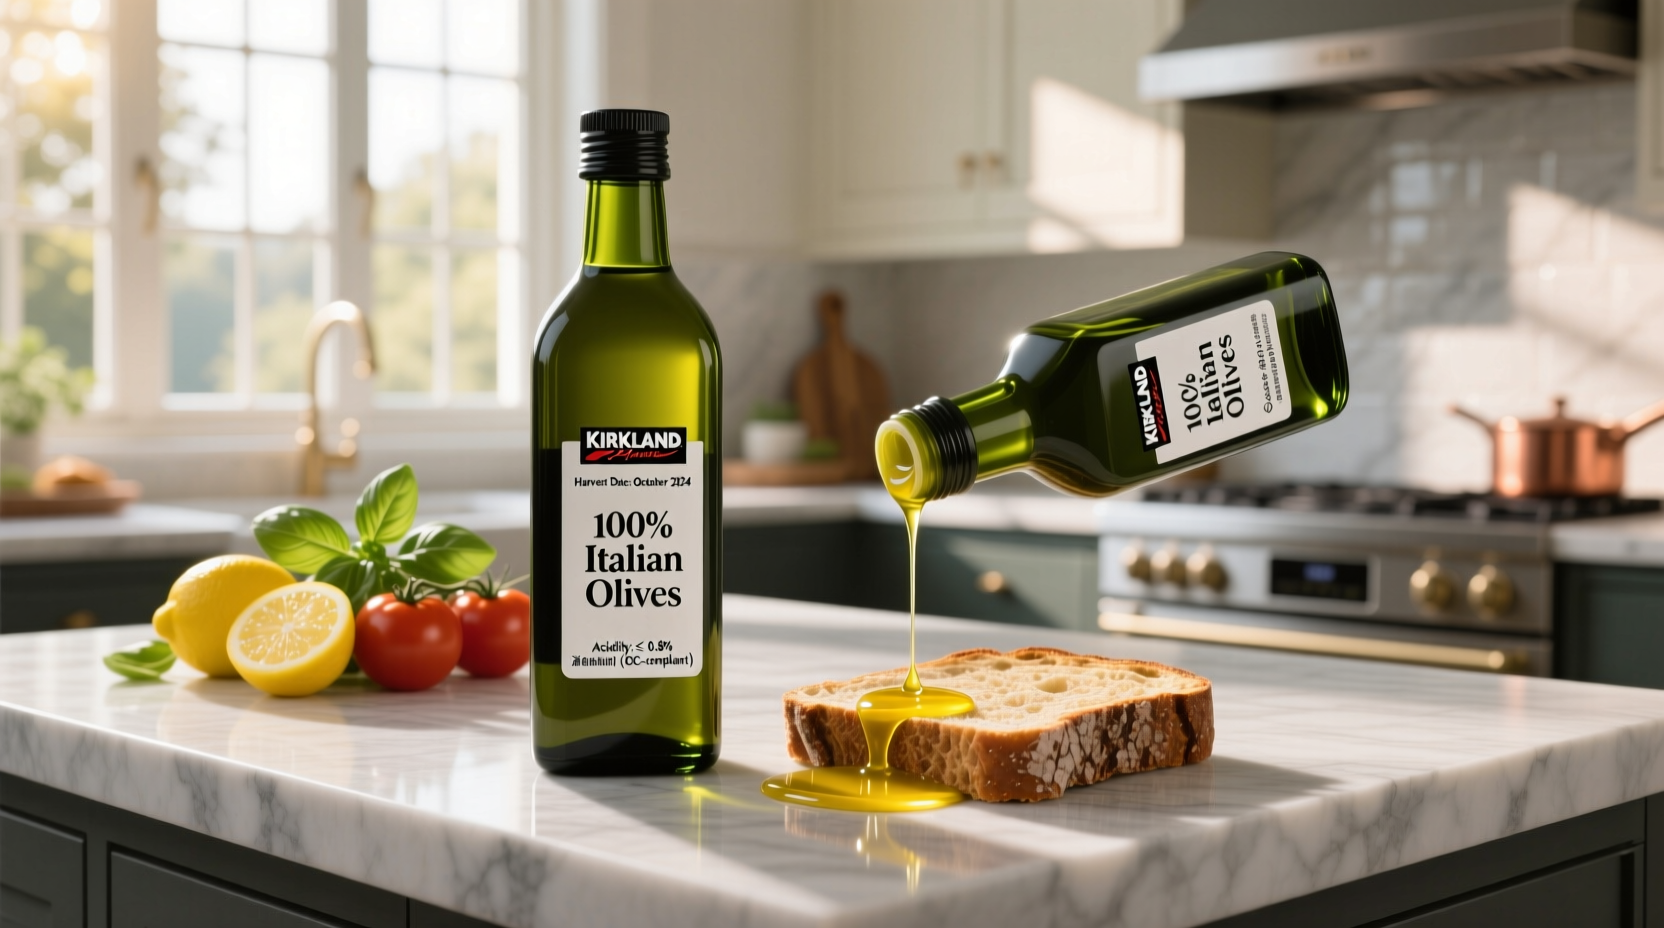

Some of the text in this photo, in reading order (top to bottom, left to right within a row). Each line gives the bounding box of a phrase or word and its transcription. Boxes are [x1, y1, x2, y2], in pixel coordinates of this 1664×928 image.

[1218, 334, 1245, 419] Olives
[586, 431, 682, 449] KIRKLAND
[593, 510, 673, 539] 100%
[585, 544, 684, 573] Italian
[585, 578, 682, 608] Olives
